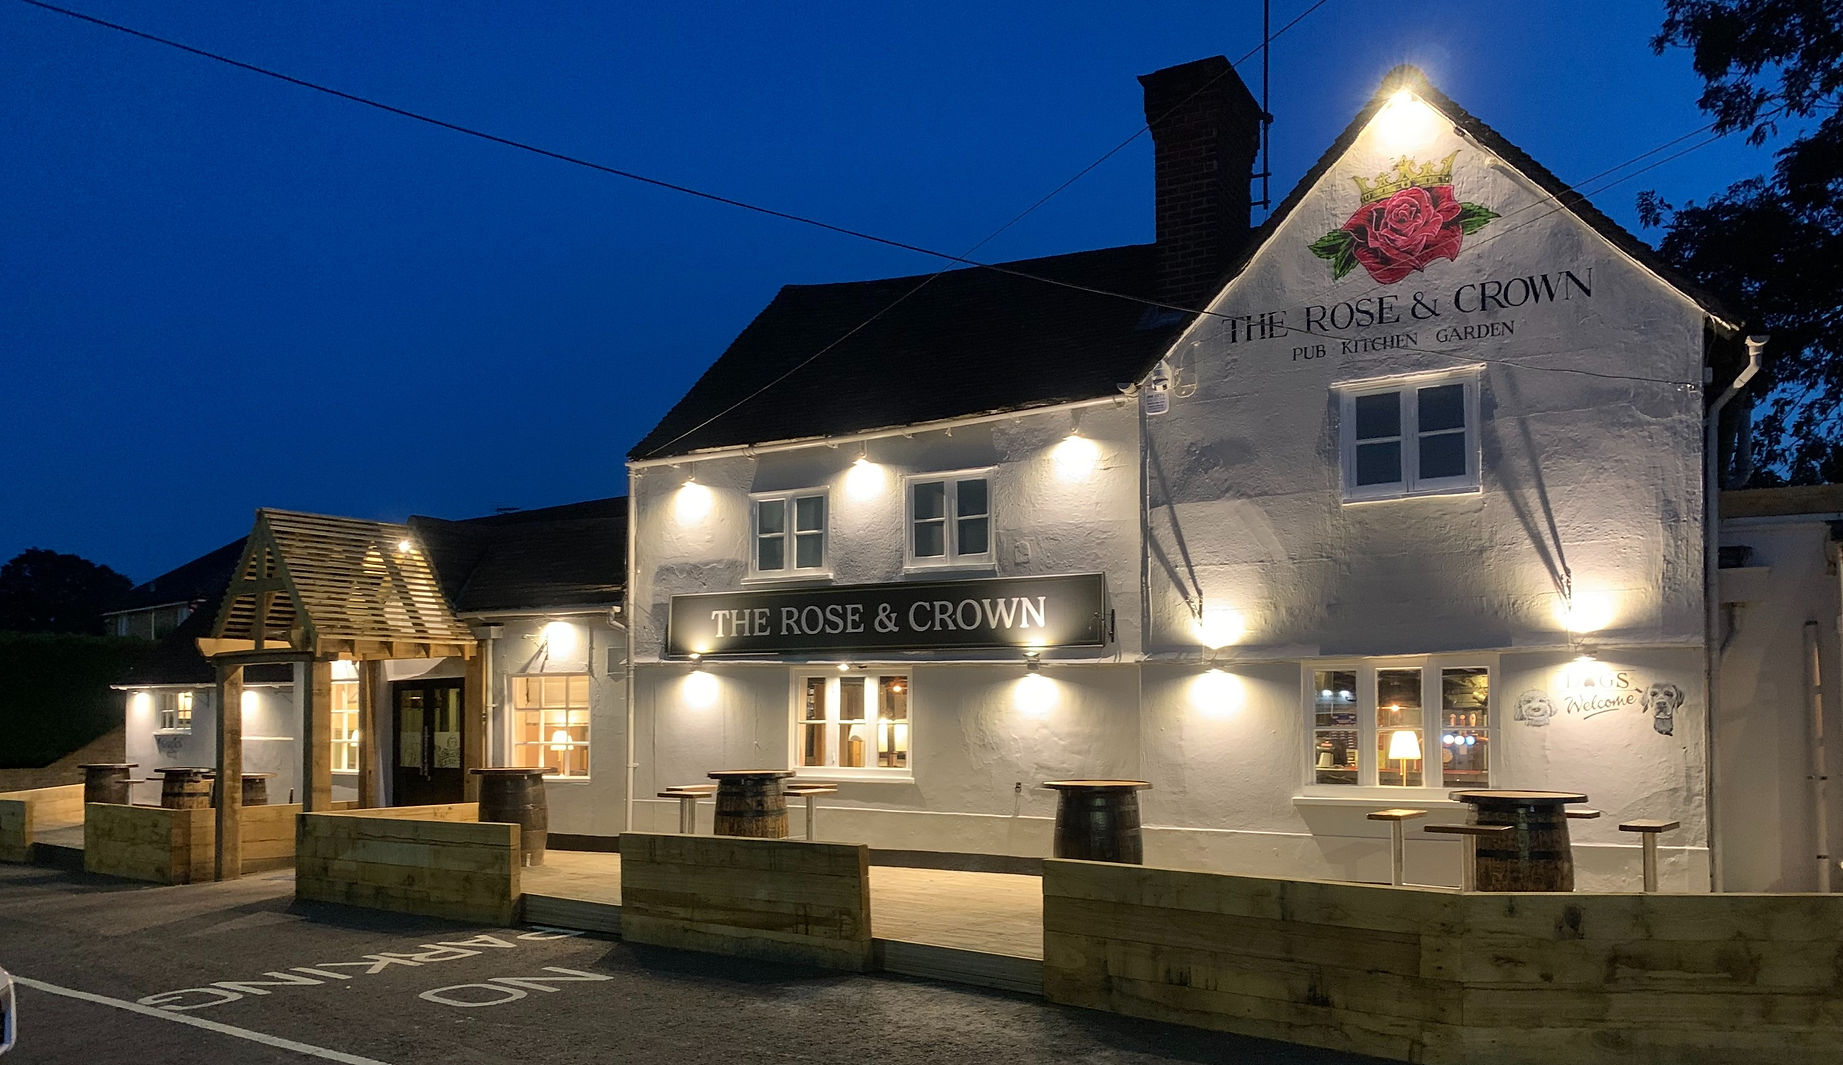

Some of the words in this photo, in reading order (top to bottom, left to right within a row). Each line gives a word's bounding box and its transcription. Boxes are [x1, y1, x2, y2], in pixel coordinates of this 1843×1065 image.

[1222, 310, 1289, 344] THE
[1305, 294, 1400, 333] ROSE
[1410, 291, 1441, 320] &
[1454, 267, 1592, 313] CROWN
[1292, 344, 1326, 361] PUB
[1341, 332, 1418, 355] KITCHEN
[1436, 320, 1515, 343] GARDEN
[711, 608, 771, 638] THE
[780, 603, 865, 636] ROSE
[873, 602, 900, 633] &
[908, 596, 1047, 632] CROWN
[1566, 672, 1629, 689] GS
[1565, 693, 1637, 714] Welcome
[136, 925, 585, 1010] PARKING
[418, 966, 615, 1007] NO
